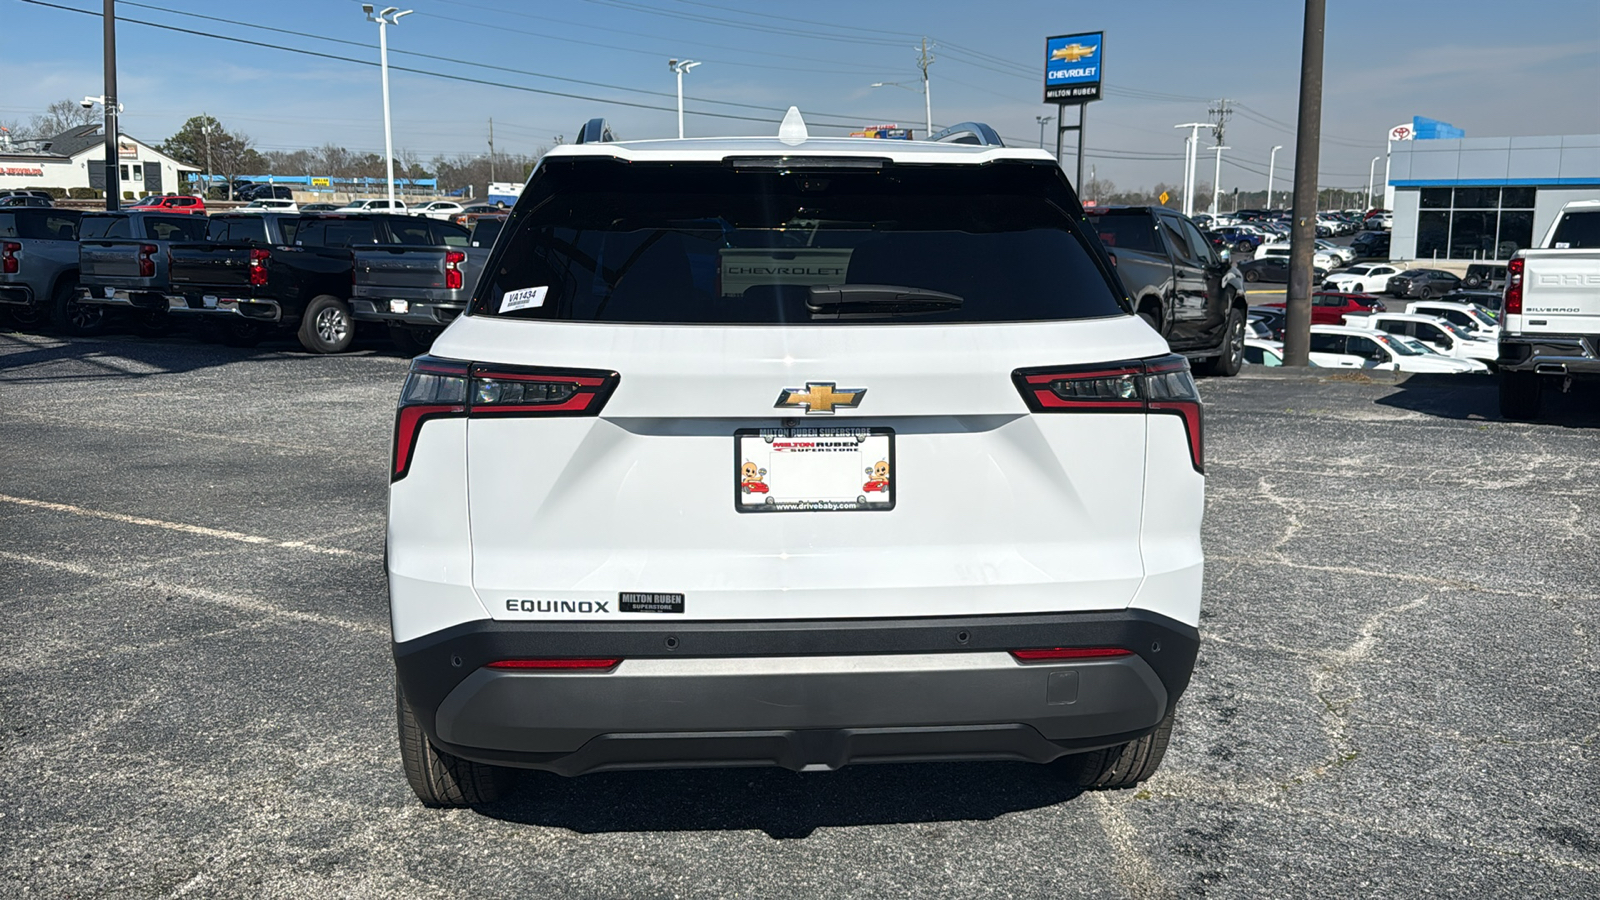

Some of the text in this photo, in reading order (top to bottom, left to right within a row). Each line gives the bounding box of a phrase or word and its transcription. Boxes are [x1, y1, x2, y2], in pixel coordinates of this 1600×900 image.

[1048, 67, 1096, 79] CHEVROLET
[1047, 87, 1097, 98] MILTON RUBEN
[728, 267, 844, 276] CHEVROLET
[509, 290, 537, 302] VA1434
[759, 427, 871, 437] MILTON RUBEN SUPERSTORE
[776, 502, 857, 511] www.drivebaby.com
[622, 594, 682, 604] MILTON RUBEN
[505, 599, 610, 613] EQUINOX
